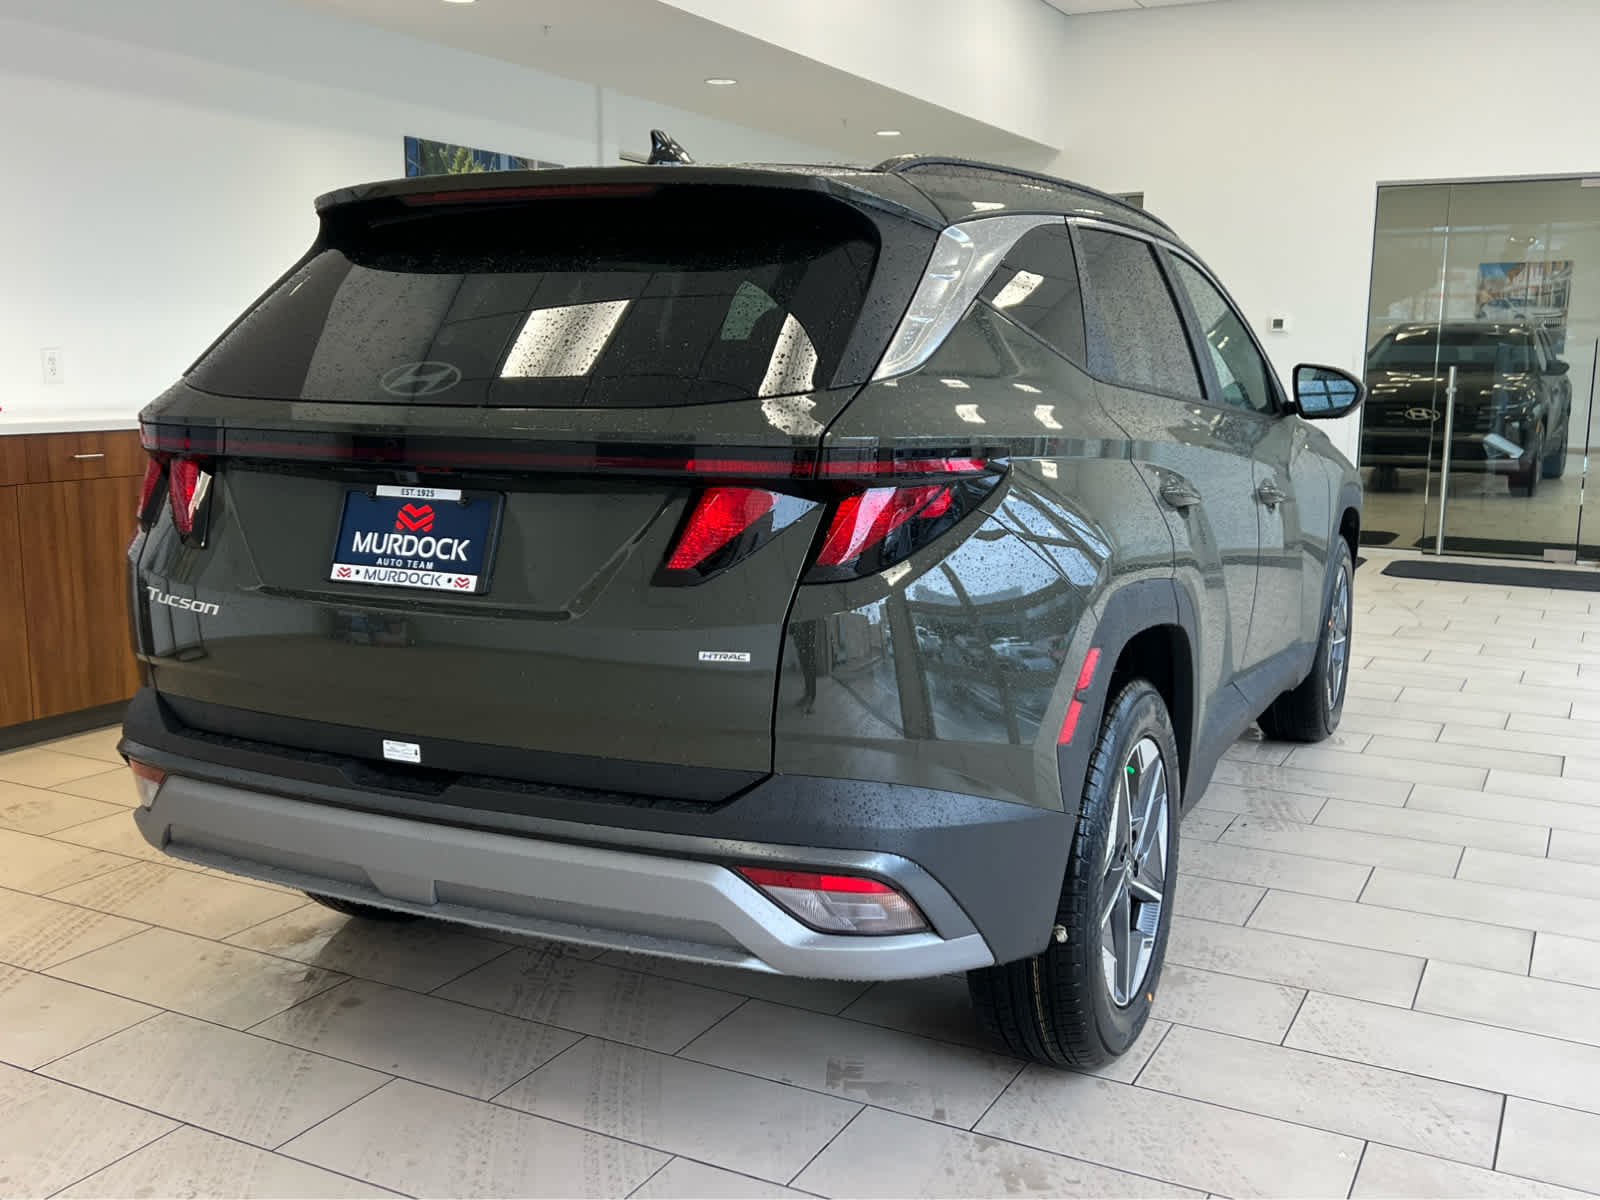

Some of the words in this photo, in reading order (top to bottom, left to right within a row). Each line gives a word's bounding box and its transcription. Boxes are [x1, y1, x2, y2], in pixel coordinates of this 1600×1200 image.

[401, 488, 415, 497] EST.
[417, 489, 435, 498] 1925
[352, 531, 471, 562] MURDOCK
[376, 557, 403, 567] AUTO
[407, 560, 434, 570] TEAM
[363, 569, 442, 587] MURDOCK
[701, 652, 748, 661] HTRAC
